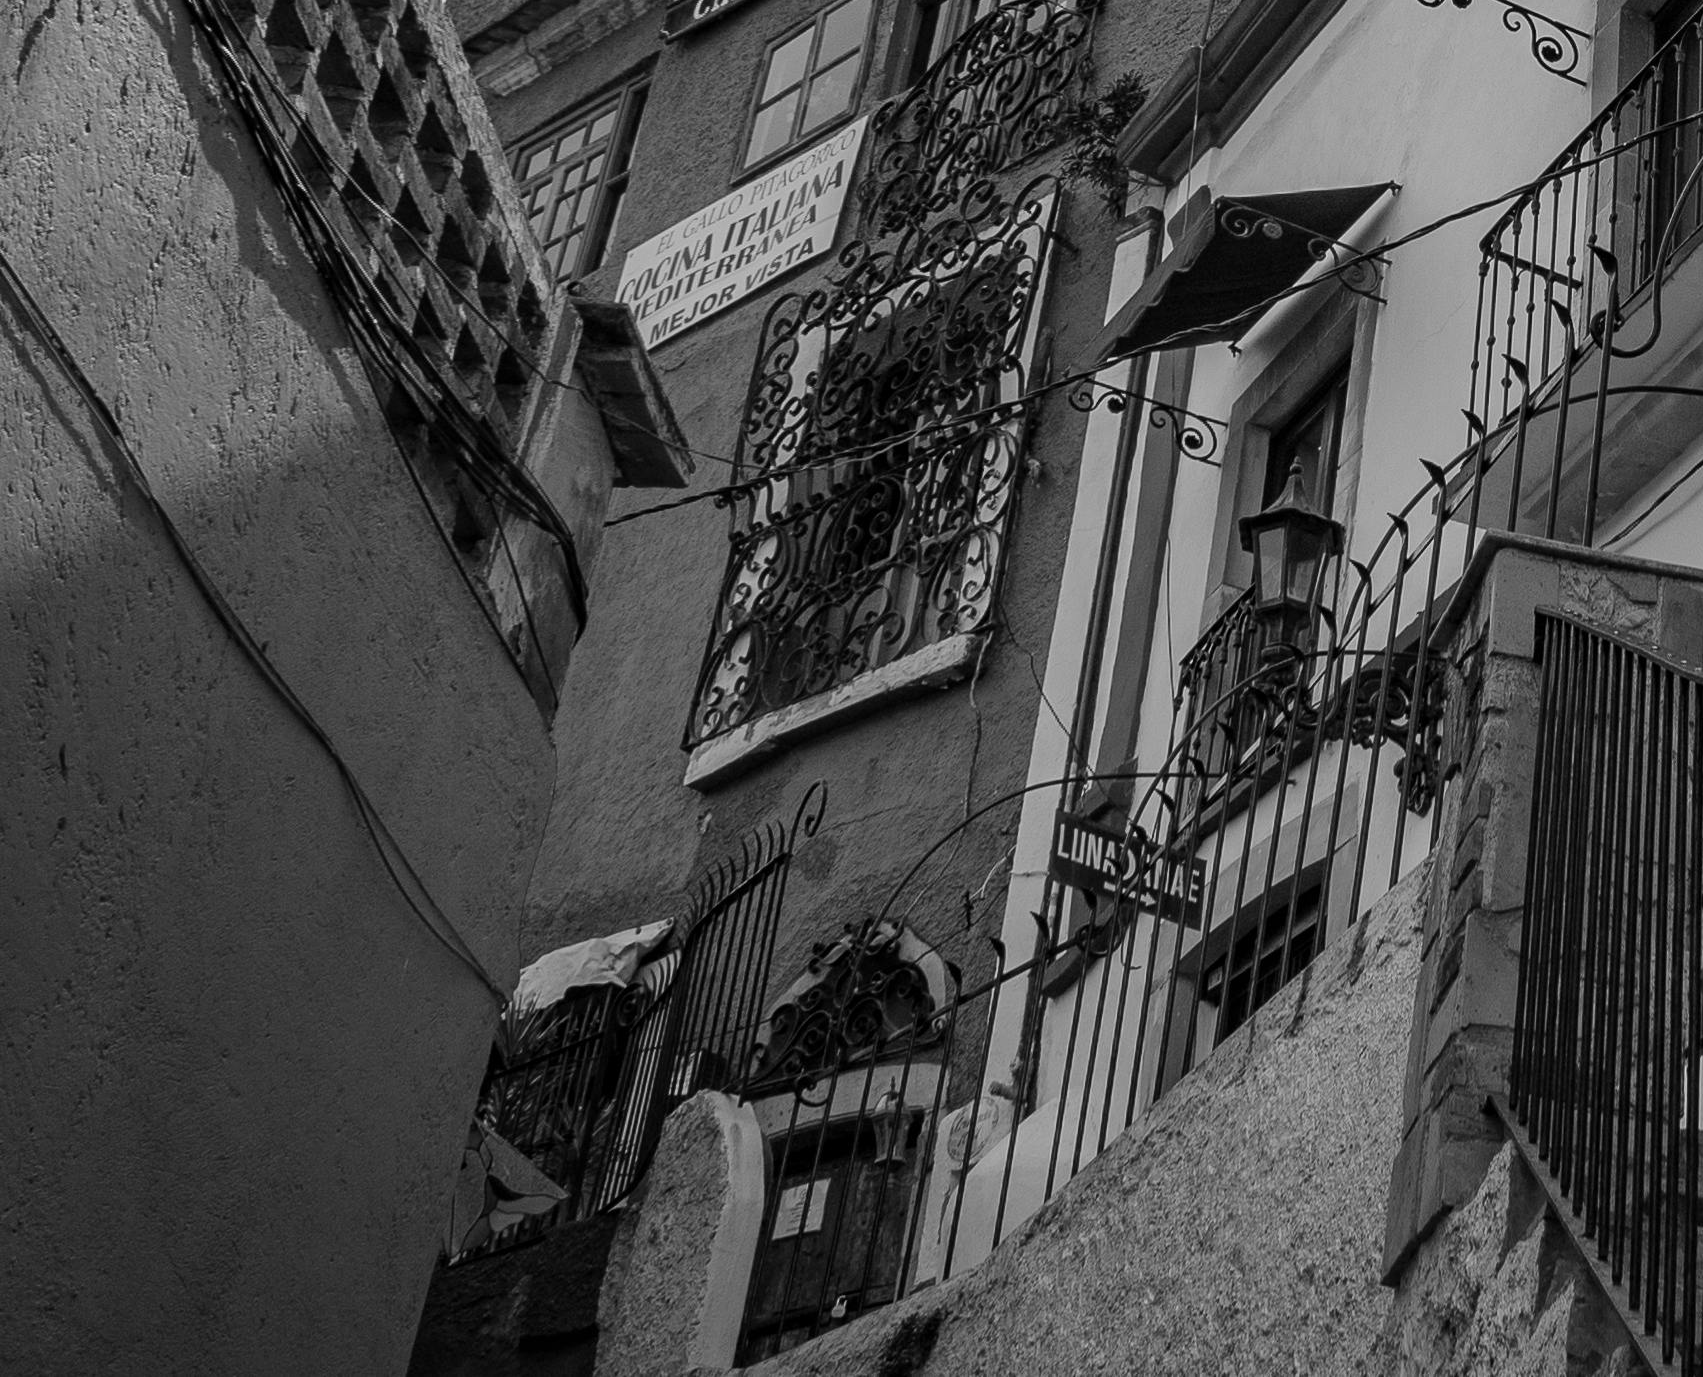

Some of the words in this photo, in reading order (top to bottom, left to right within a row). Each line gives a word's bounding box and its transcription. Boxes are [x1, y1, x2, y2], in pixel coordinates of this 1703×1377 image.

[619, 233, 714, 306] COCINA
[721, 159, 845, 253] ITALIANA
[655, 233, 674, 256] EL
[683, 194, 743, 238] GALLO
[750, 129, 857, 205] PITAGORICO
[649, 284, 737, 344] MEJOR
[745, 237, 814, 291] VISTA
